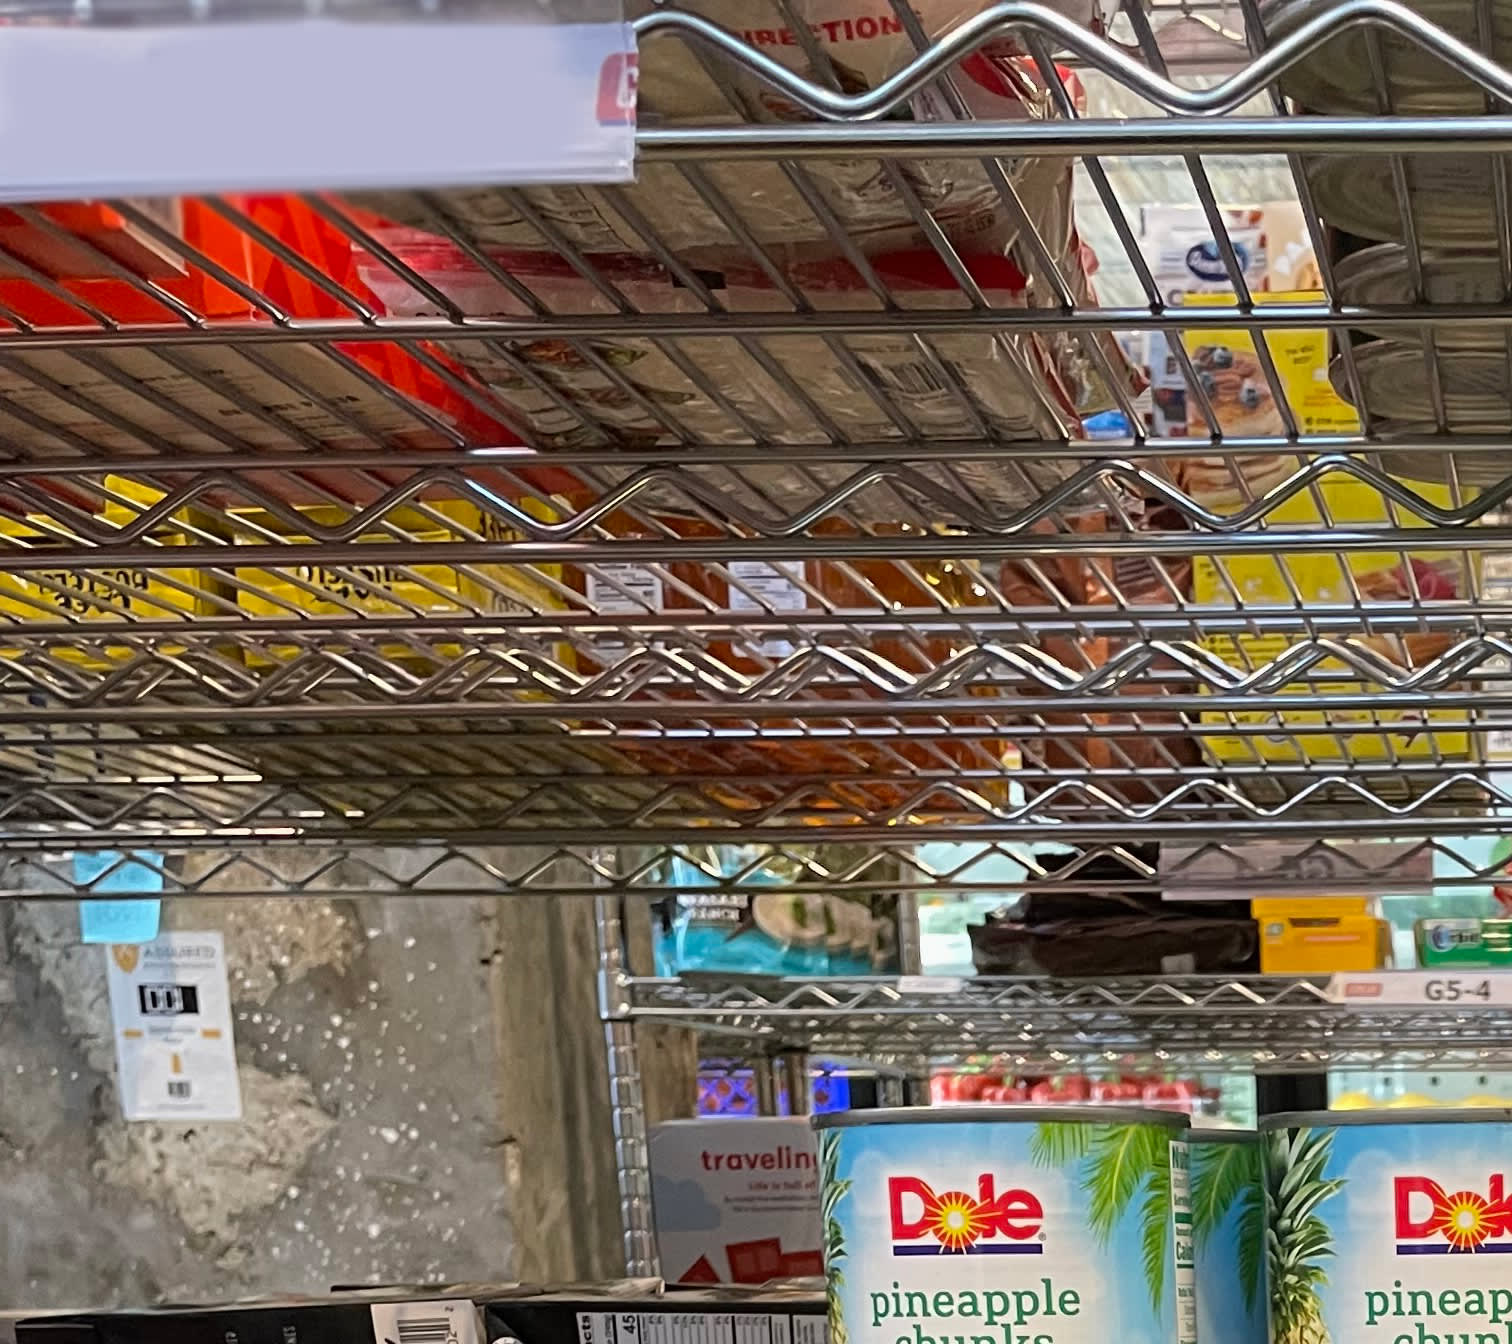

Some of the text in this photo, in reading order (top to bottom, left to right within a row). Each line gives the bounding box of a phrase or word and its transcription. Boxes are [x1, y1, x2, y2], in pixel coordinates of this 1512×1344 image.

[1425, 980, 1491, 1001] G5-4
[888, 1173, 1044, 1250] Dole
[870, 1278, 1080, 1326] pineapple
[622, 1315, 635, 1334] 45
